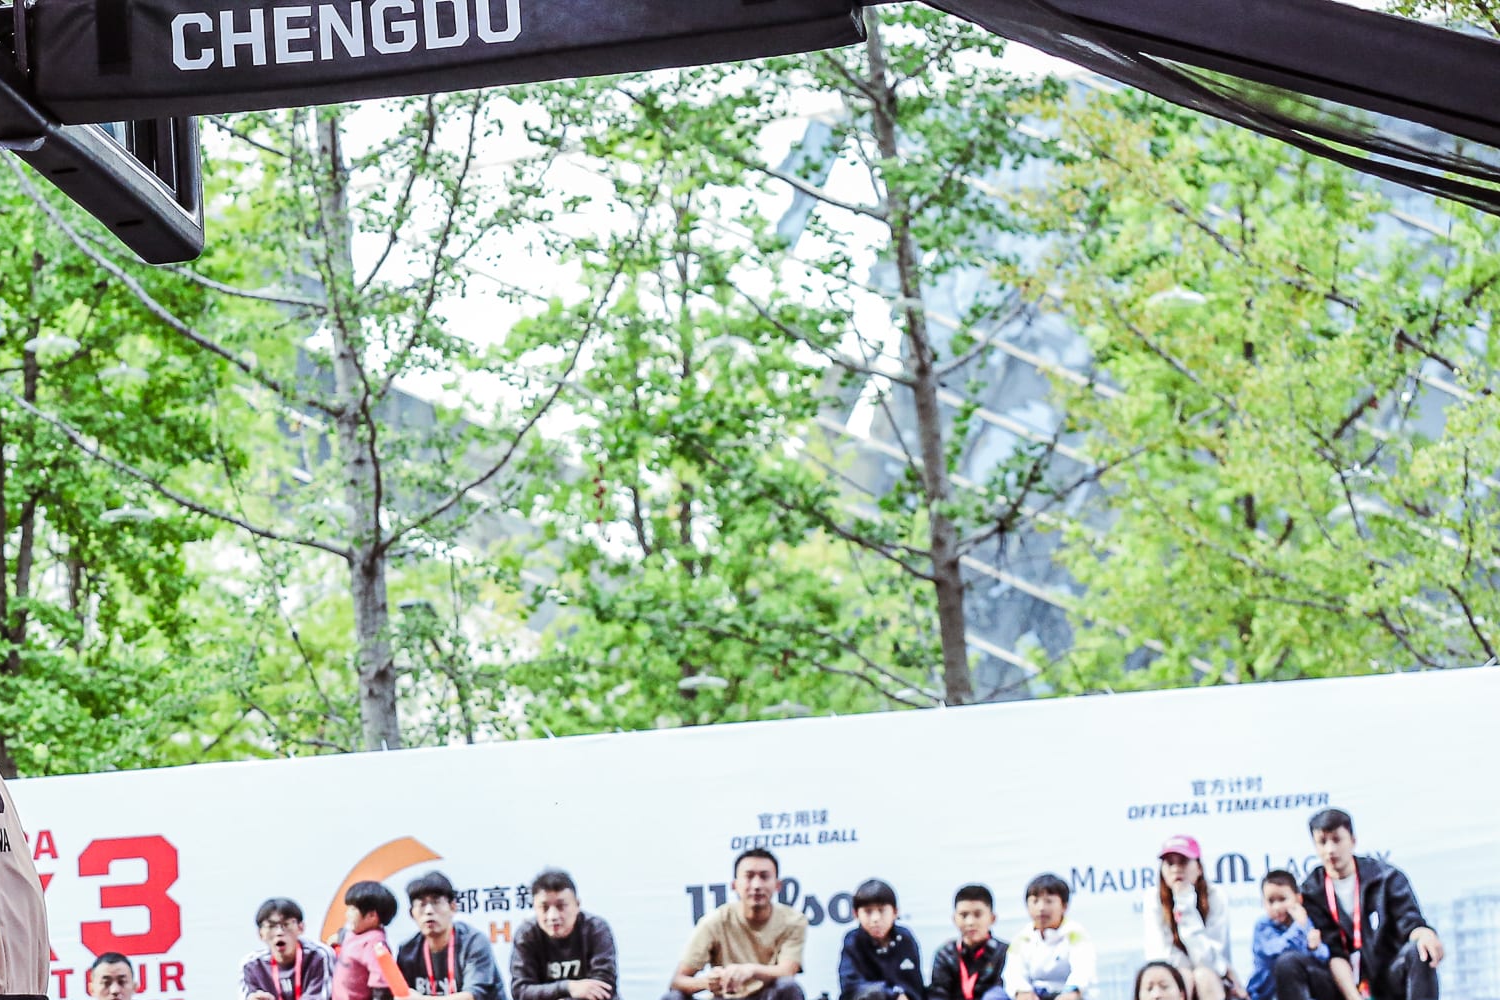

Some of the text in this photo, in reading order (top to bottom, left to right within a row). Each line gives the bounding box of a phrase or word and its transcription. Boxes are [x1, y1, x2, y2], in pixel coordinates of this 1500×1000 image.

[171, 0, 522, 71] CHENGDU
[1127, 792, 1329, 820] OFFICIAL TIMEKEEPER
[731, 828, 859, 851] OFFICIAL BALL
